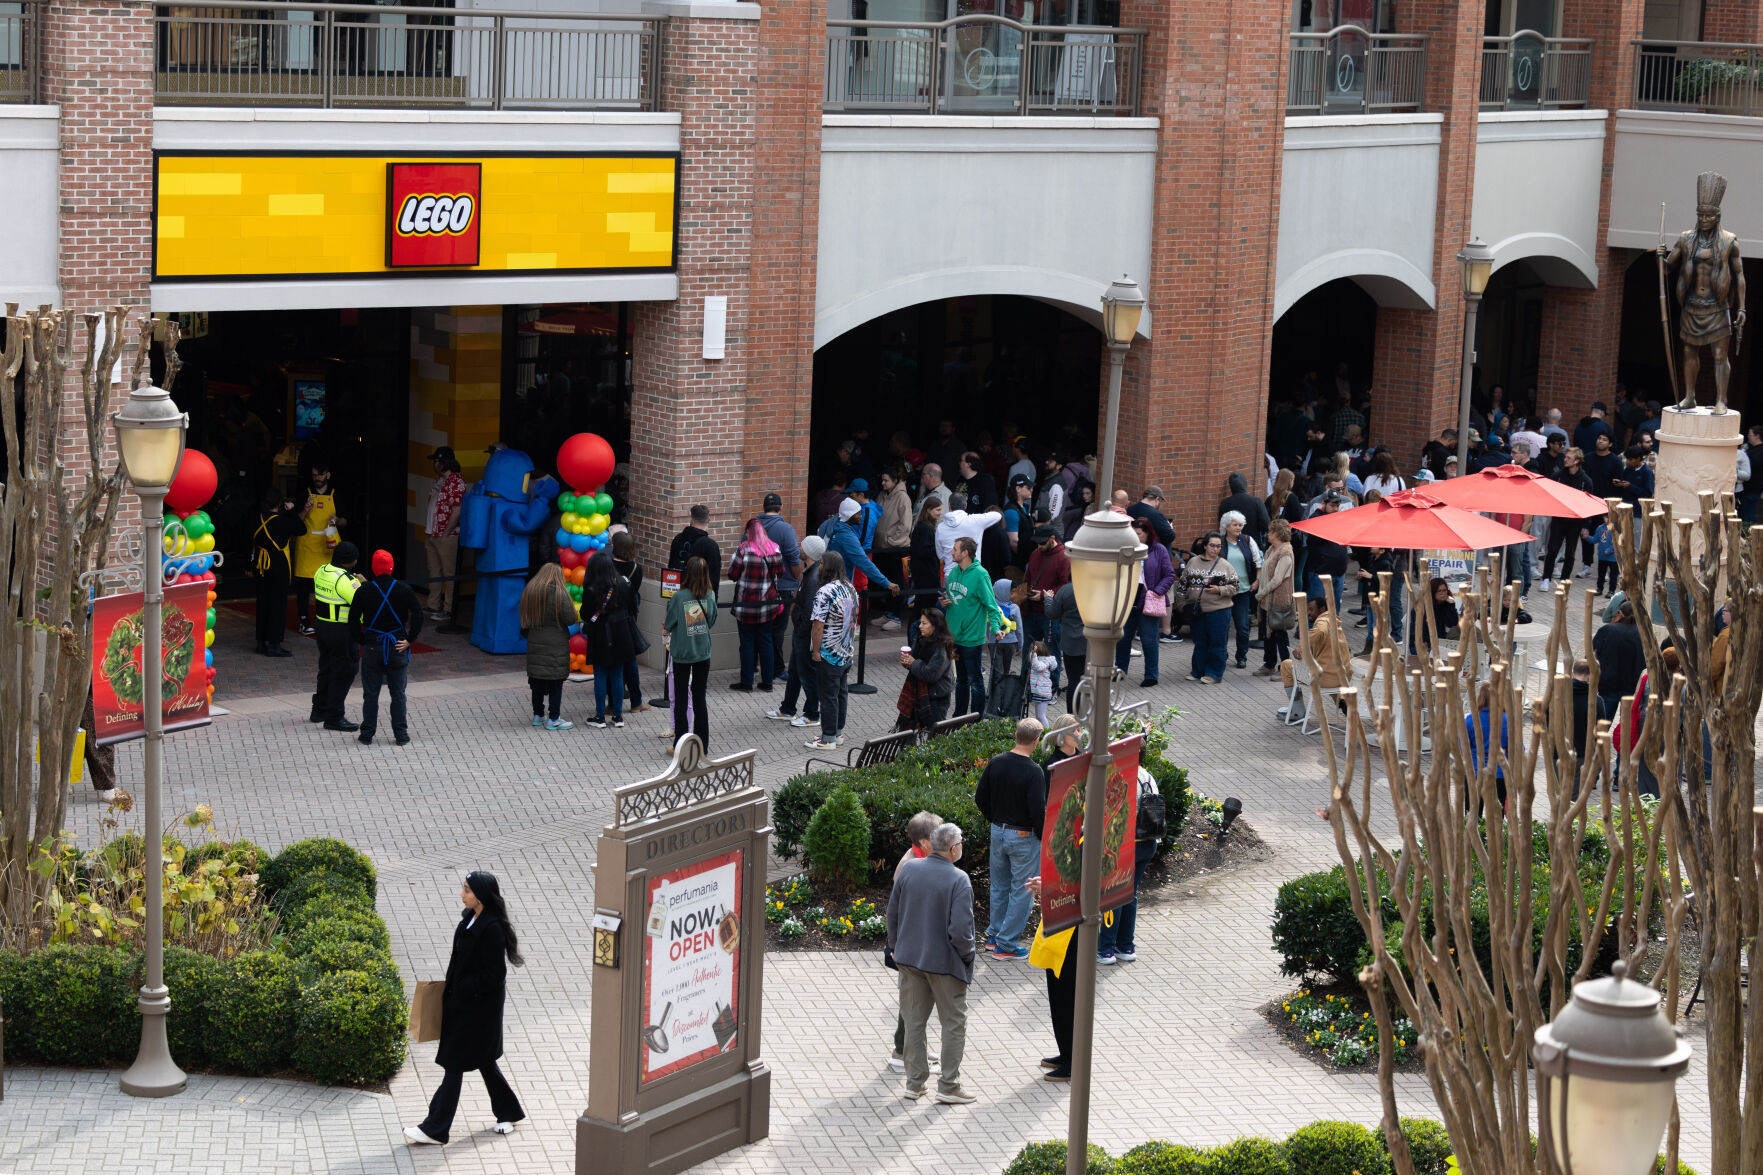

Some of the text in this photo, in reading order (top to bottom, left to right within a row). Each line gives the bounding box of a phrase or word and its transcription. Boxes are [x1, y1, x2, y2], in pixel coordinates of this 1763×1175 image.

[397, 194, 474, 236] LEGO
[1428, 559, 1463, 568] REPAIR
[1447, 551, 1474, 560] PHONE
[105, 711, 138, 725] Defining
[646, 813, 746, 860] DIRECTORY
[670, 881, 718, 909] perfumania
[1050, 893, 1076, 910] Defining
[670, 928, 715, 961] OPEN
[691, 963, 722, 987] Authentic
[672, 1009, 710, 1039] Discounted
[682, 1034, 699, 1045] Prices
